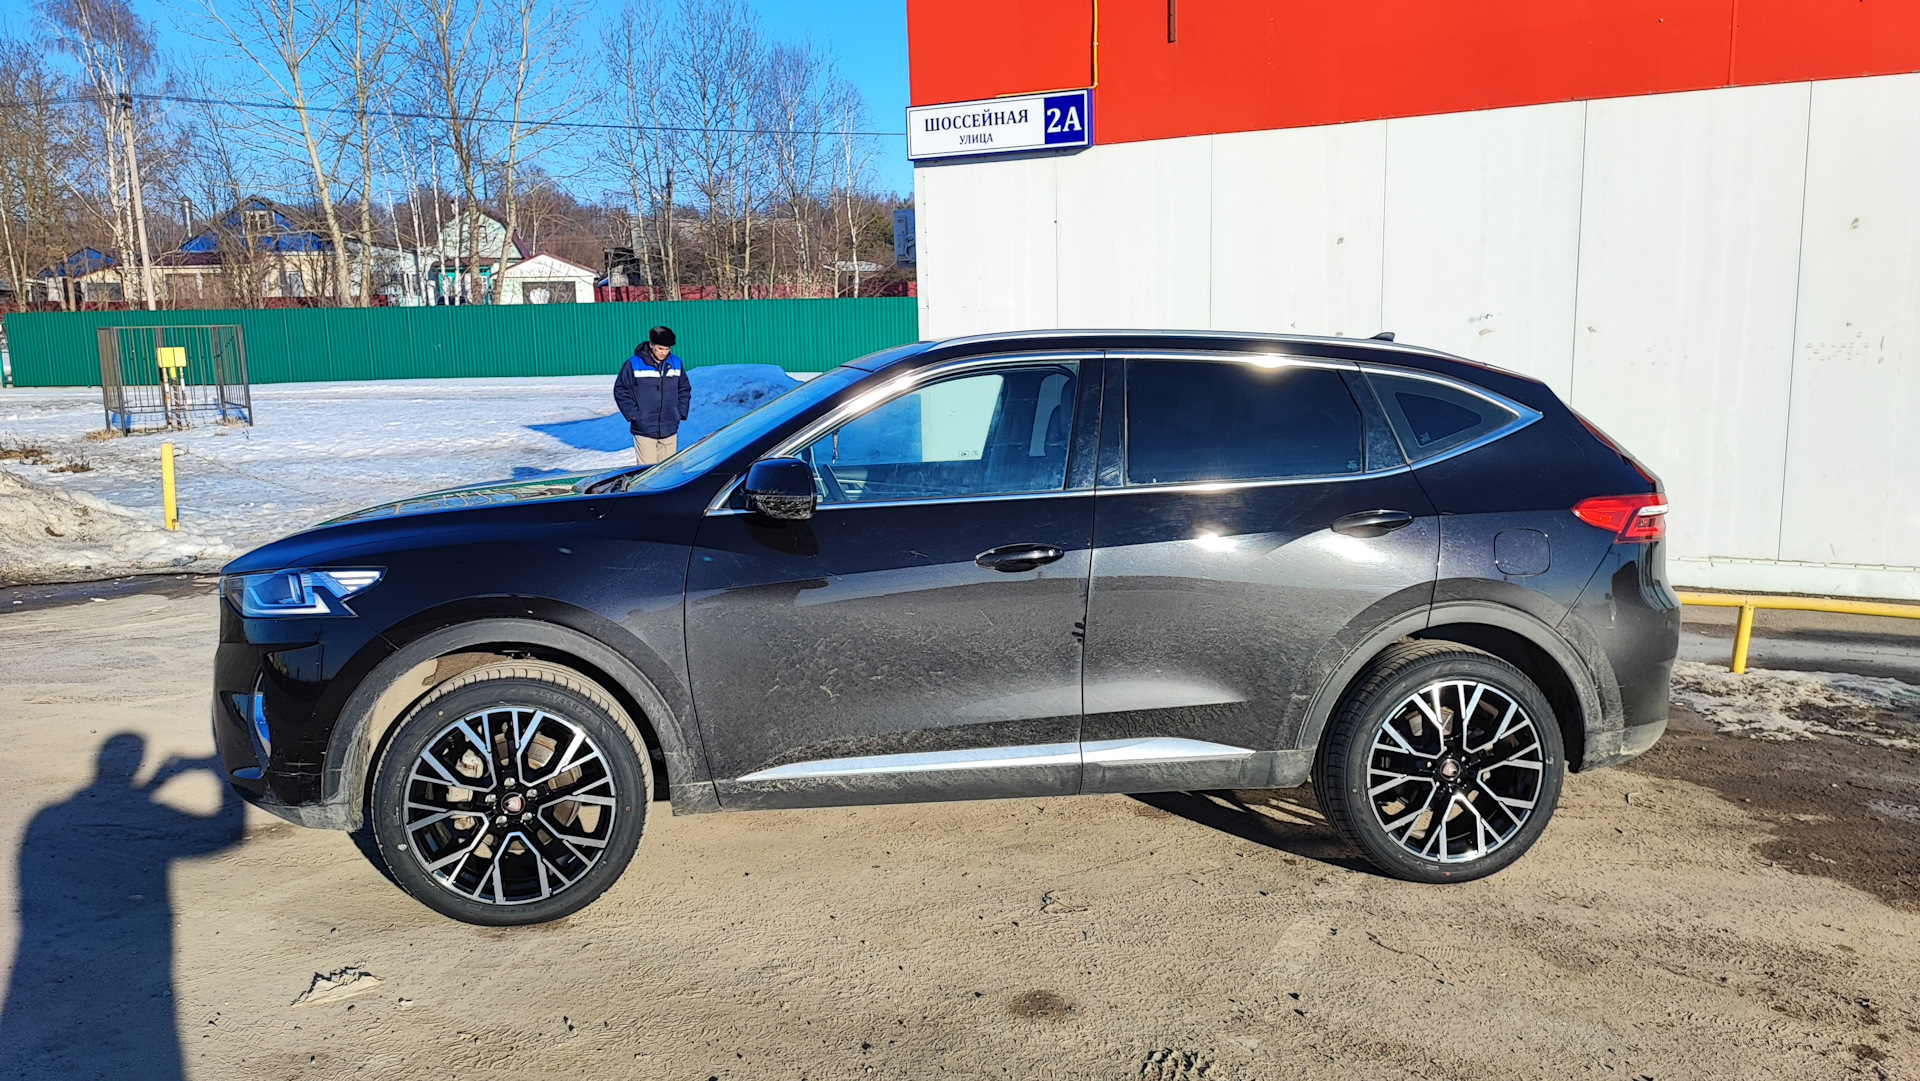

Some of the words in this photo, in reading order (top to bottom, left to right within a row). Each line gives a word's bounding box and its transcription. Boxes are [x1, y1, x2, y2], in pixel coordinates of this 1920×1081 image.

[925, 109, 1028, 132] ШОССЕЙНАЯ
[1047, 106, 1082, 133] 2А
[959, 133, 993, 145] УЛИЦА
[534, 690, 592, 719] 255/45R20
